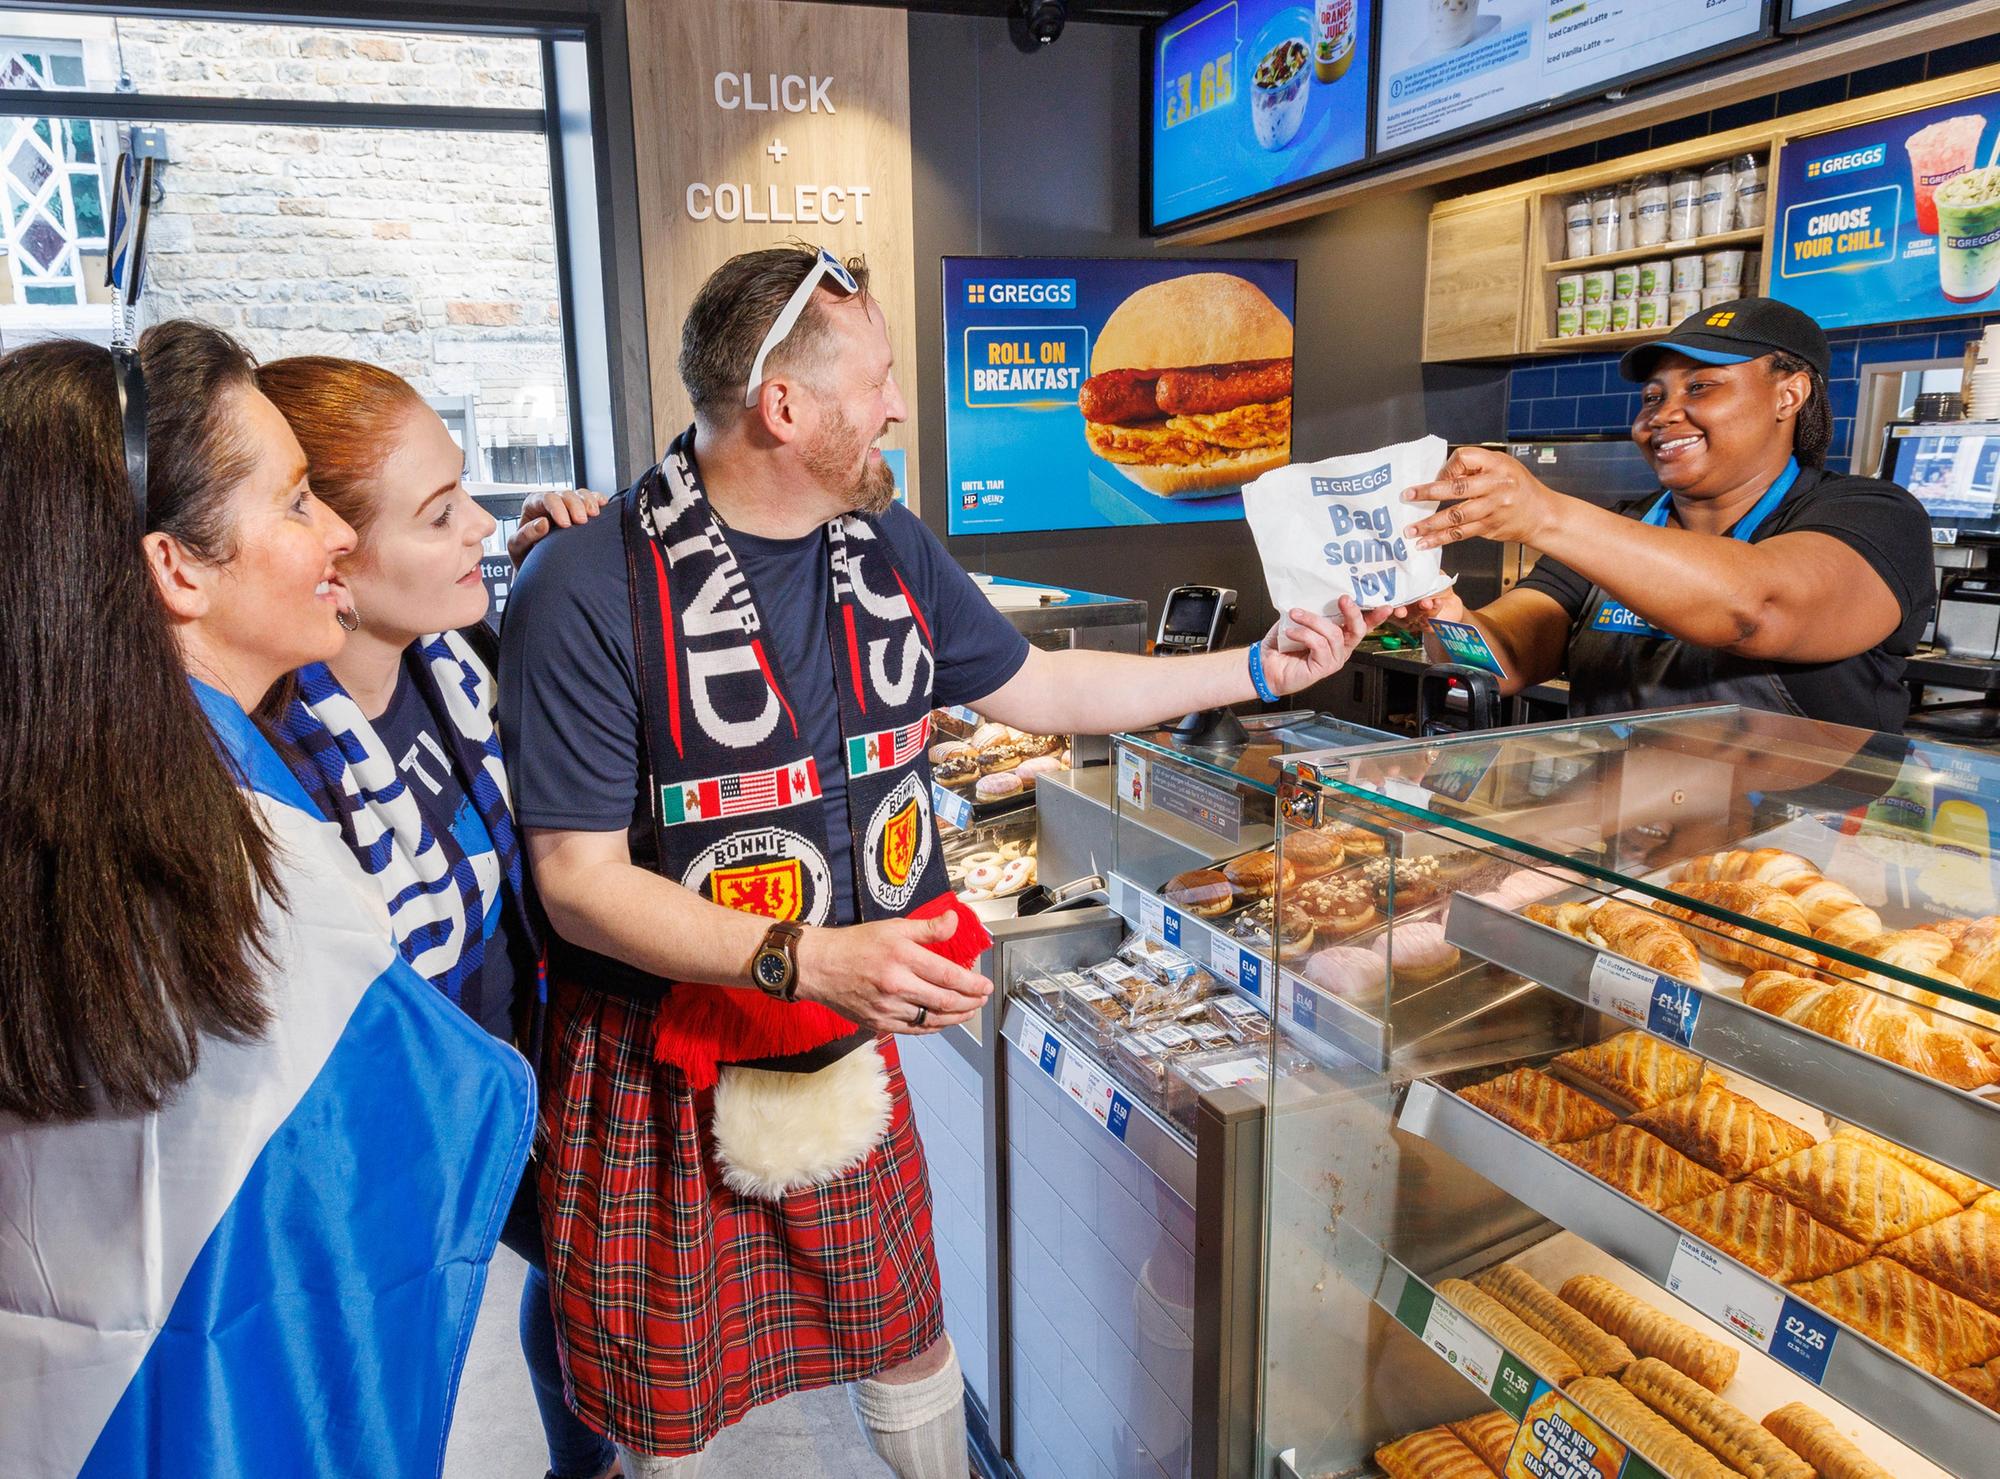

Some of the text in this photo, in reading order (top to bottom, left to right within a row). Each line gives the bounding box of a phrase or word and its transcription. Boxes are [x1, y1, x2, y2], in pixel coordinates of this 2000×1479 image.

[1320, 0, 1352, 25] ORANGE
[1548, 27, 1562, 40] Iced
[1563, 18, 1590, 35] Caramel
[1590, 10, 1608, 26] Latte
[1324, 19, 1347, 39] JUICE
[1546, 53, 1560, 64] Iced
[1561, 44, 1583, 60] Vanilla
[1583, 38, 1601, 51] Latte
[714, 71, 836, 115] CLICK
[1821, 147, 1883, 174] GREGGS
[686, 182, 871, 225] COLLECT
[1807, 206, 1872, 237] CHOOSE
[1793, 228, 1885, 261] YOUR CHILL
[1902, 246, 1937, 259] LEMONADE
[1907, 238, 1933, 249] CHERRY
[989, 284, 1071, 303] GREGGS
[988, 342, 1066, 365] ROLL ON
[973, 367, 1081, 391] BREAKFAST
[961, 479, 1005, 491] UNTIL 11AM
[1330, 468, 1388, 493] GREGGS
[964, 494, 1005, 505] HP HEINZ
[1327, 504, 1393, 539] Bag
[1322, 537, 1408, 566] some
[1350, 566, 1397, 608] joy
[1440, 623, 1470, 643] TAP
[1441, 638, 1488, 658] YOUR APP
[889, 780, 916, 814] BONNIE
[714, 834, 787, 865] BONNIE
[1165, 915, 1178, 930] £1.40
[1242, 959, 1257, 976] £1.40
[1606, 960, 1626, 973] Butter
[1625, 965, 1656, 985] Croissant
[1296, 992, 1313, 1010] £1.40
[1657, 993, 1693, 1018] £1.45
[1045, 1041, 1057, 1058] £1.50
[1113, 1101, 1128, 1120] £1.50
[1680, 1238, 1719, 1265] Steak Bake
[1784, 1315, 1827, 1351] £2.25
[1502, 1367, 1529, 1394] £1.35
[1533, 1419, 1603, 1479] Chicken
[1551, 1414, 1597, 1459] OUR NEW
[1524, 1453, 1545, 1477] HAS
[1542, 1448, 1582, 1479] Roll
